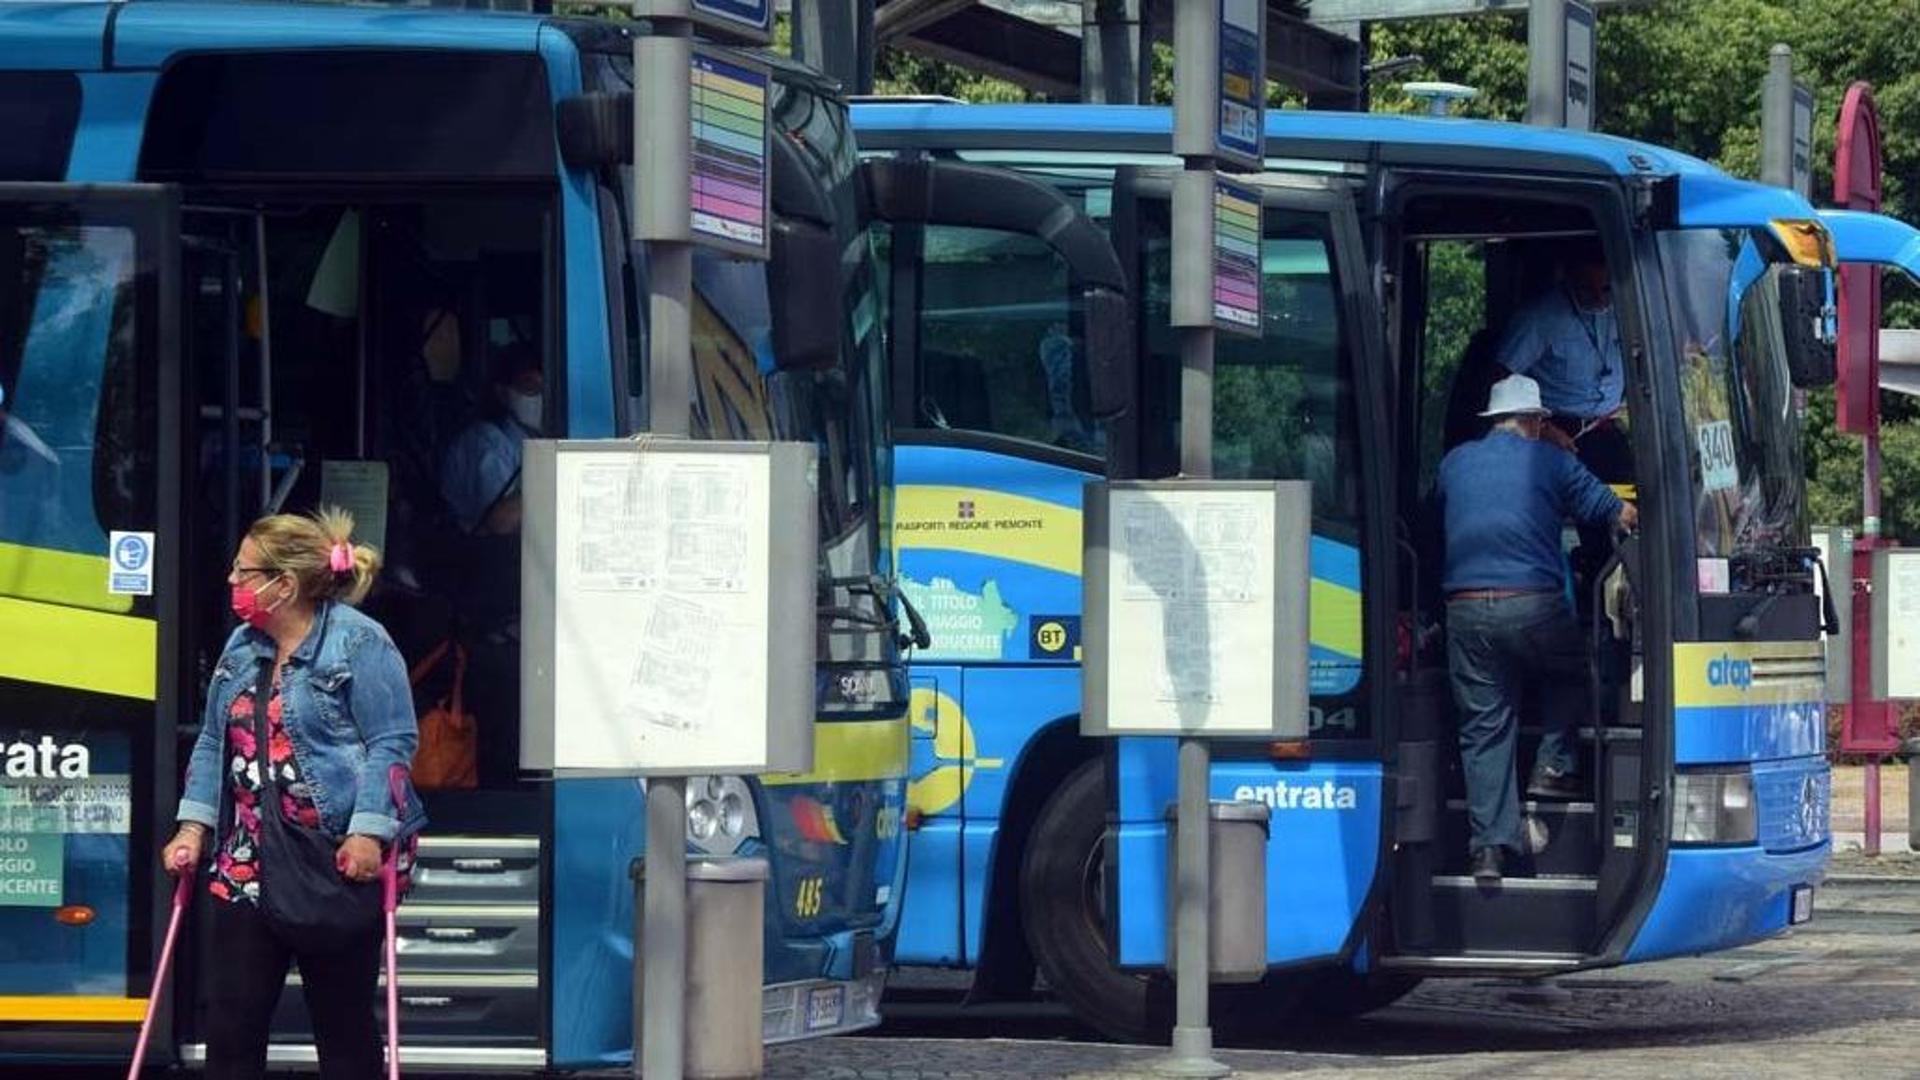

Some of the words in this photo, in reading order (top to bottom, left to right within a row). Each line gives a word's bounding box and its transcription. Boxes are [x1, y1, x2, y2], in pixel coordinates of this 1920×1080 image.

[1701, 424, 1733, 471] 340
[949, 520, 989, 531] REGIONE
[994, 519, 1043, 530] PIEMONTE
[1041, 629, 1062, 645] BT
[1708, 653, 1751, 691] atap
[0, 735, 90, 779] ata
[1234, 780, 1357, 809] entrata
[797, 878, 823, 917] 485
